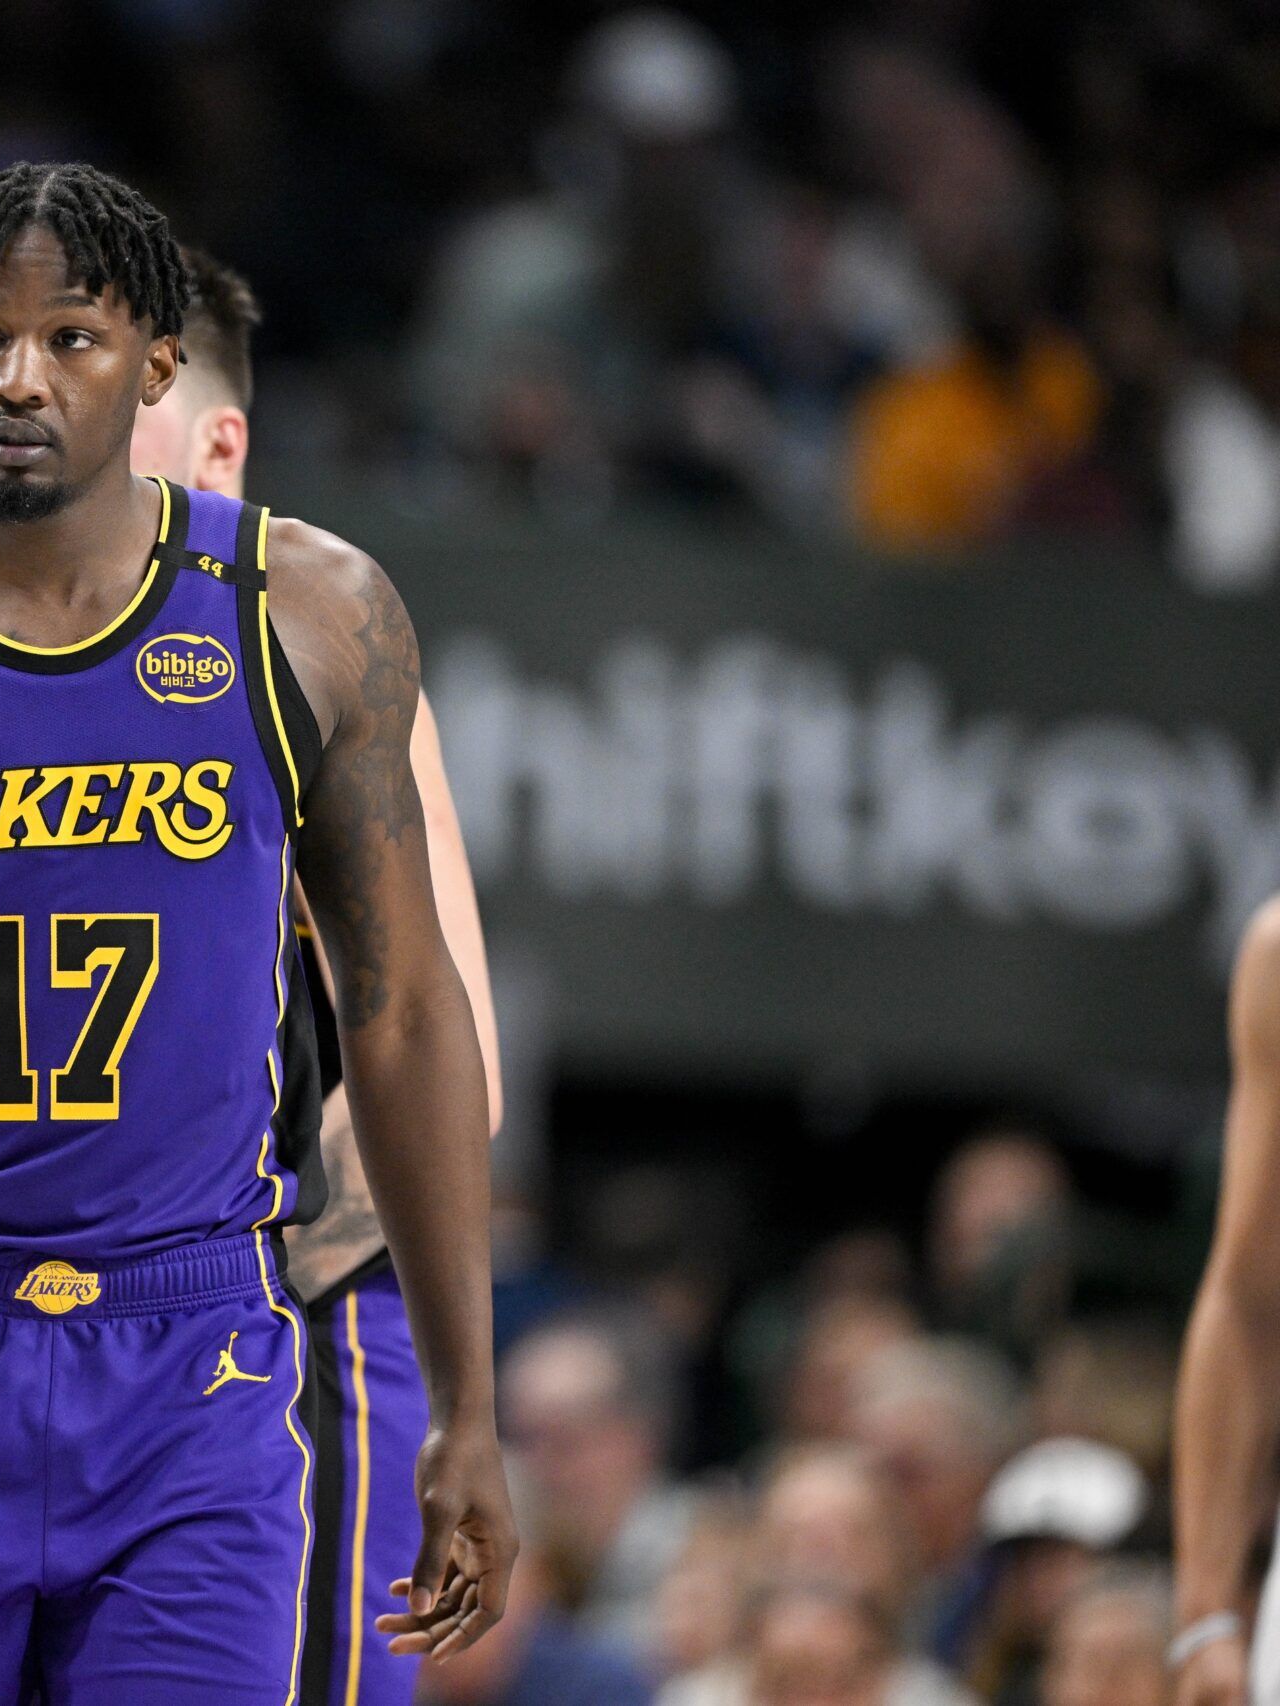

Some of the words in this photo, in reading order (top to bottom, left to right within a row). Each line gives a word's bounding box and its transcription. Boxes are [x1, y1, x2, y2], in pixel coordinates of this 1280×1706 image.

[198, 555, 224, 578] 44
[146, 651, 229, 683] bibigo
[160, 675, 195, 688] 비비고
[20, 1274, 95, 1302] LAKERS
